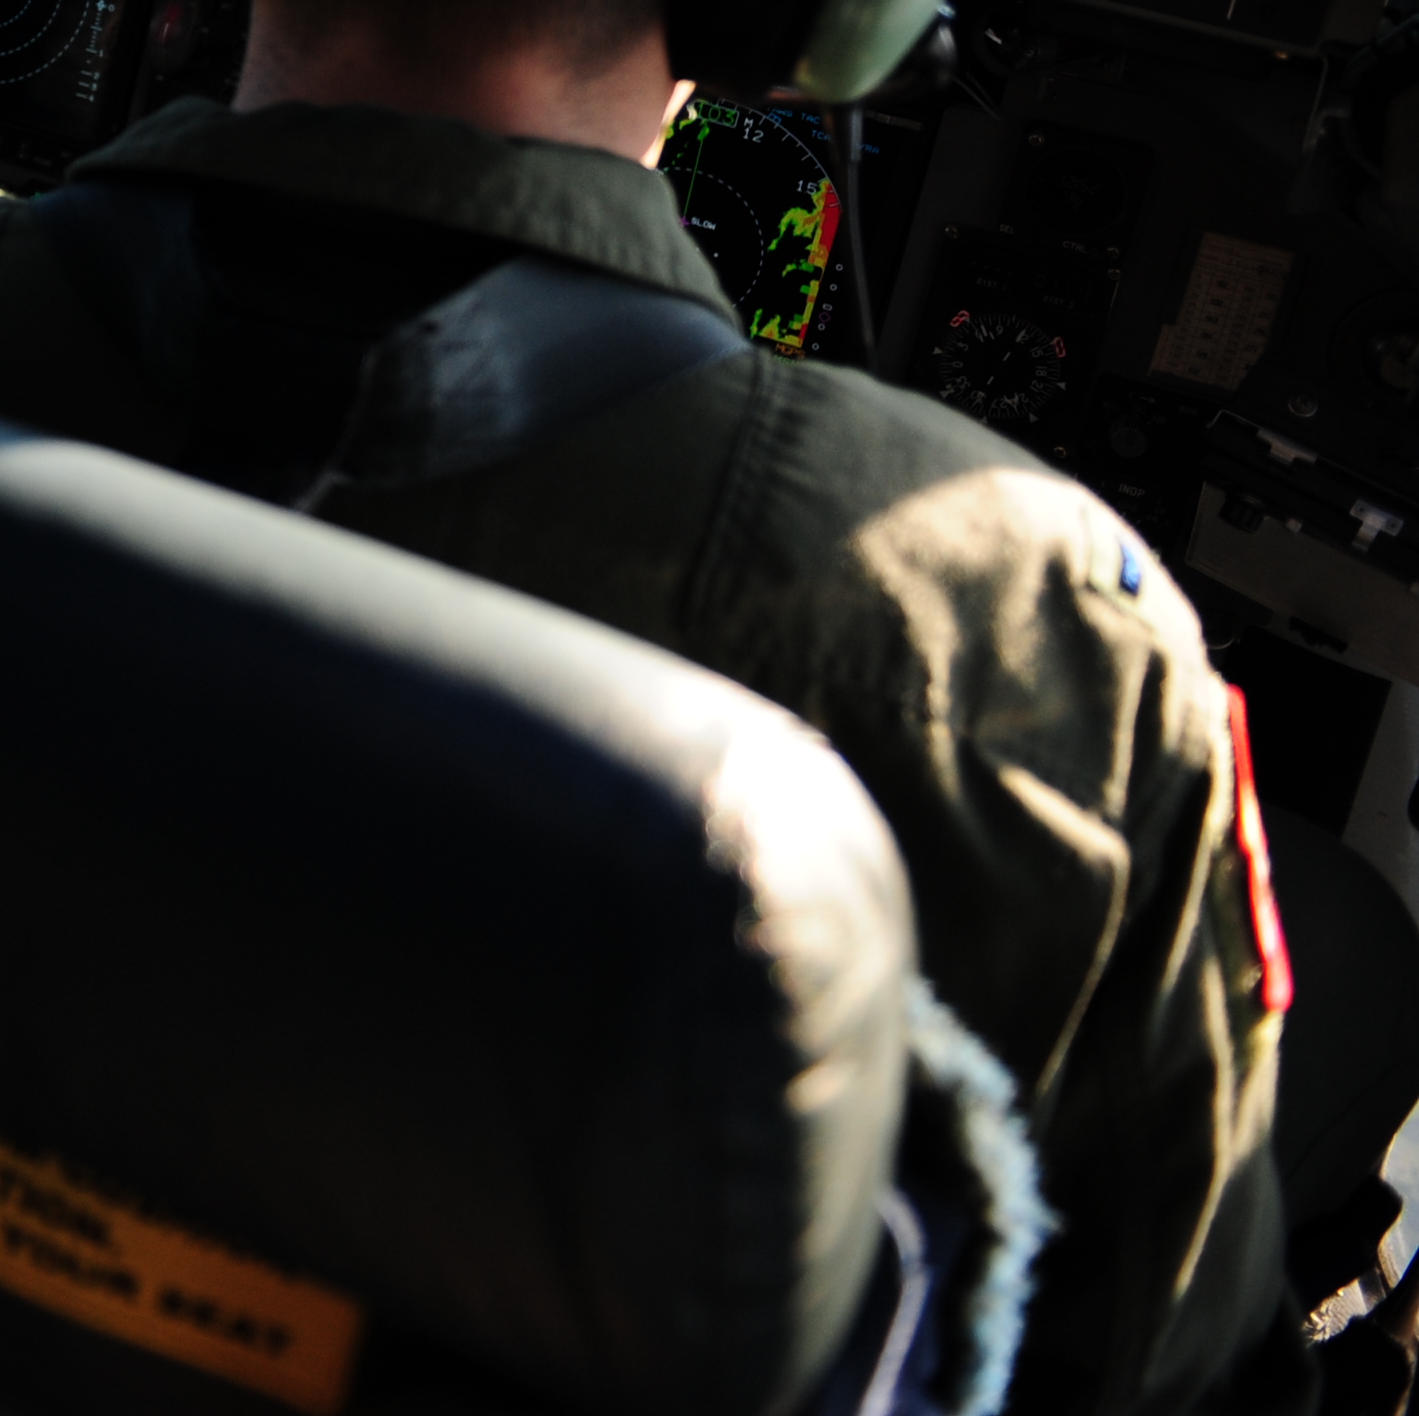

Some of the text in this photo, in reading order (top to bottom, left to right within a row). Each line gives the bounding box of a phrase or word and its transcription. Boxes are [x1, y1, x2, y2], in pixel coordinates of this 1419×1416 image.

[743, 128, 764, 143] 12
[797, 180, 818, 195] 15
[999, 223, 1015, 235] SEL
[1062, 240, 1087, 254] CTRL
[1119, 483, 1146, 498] INOP
[1, 1221, 139, 1304] YOUR
[158, 1287, 294, 1359] SEAT
